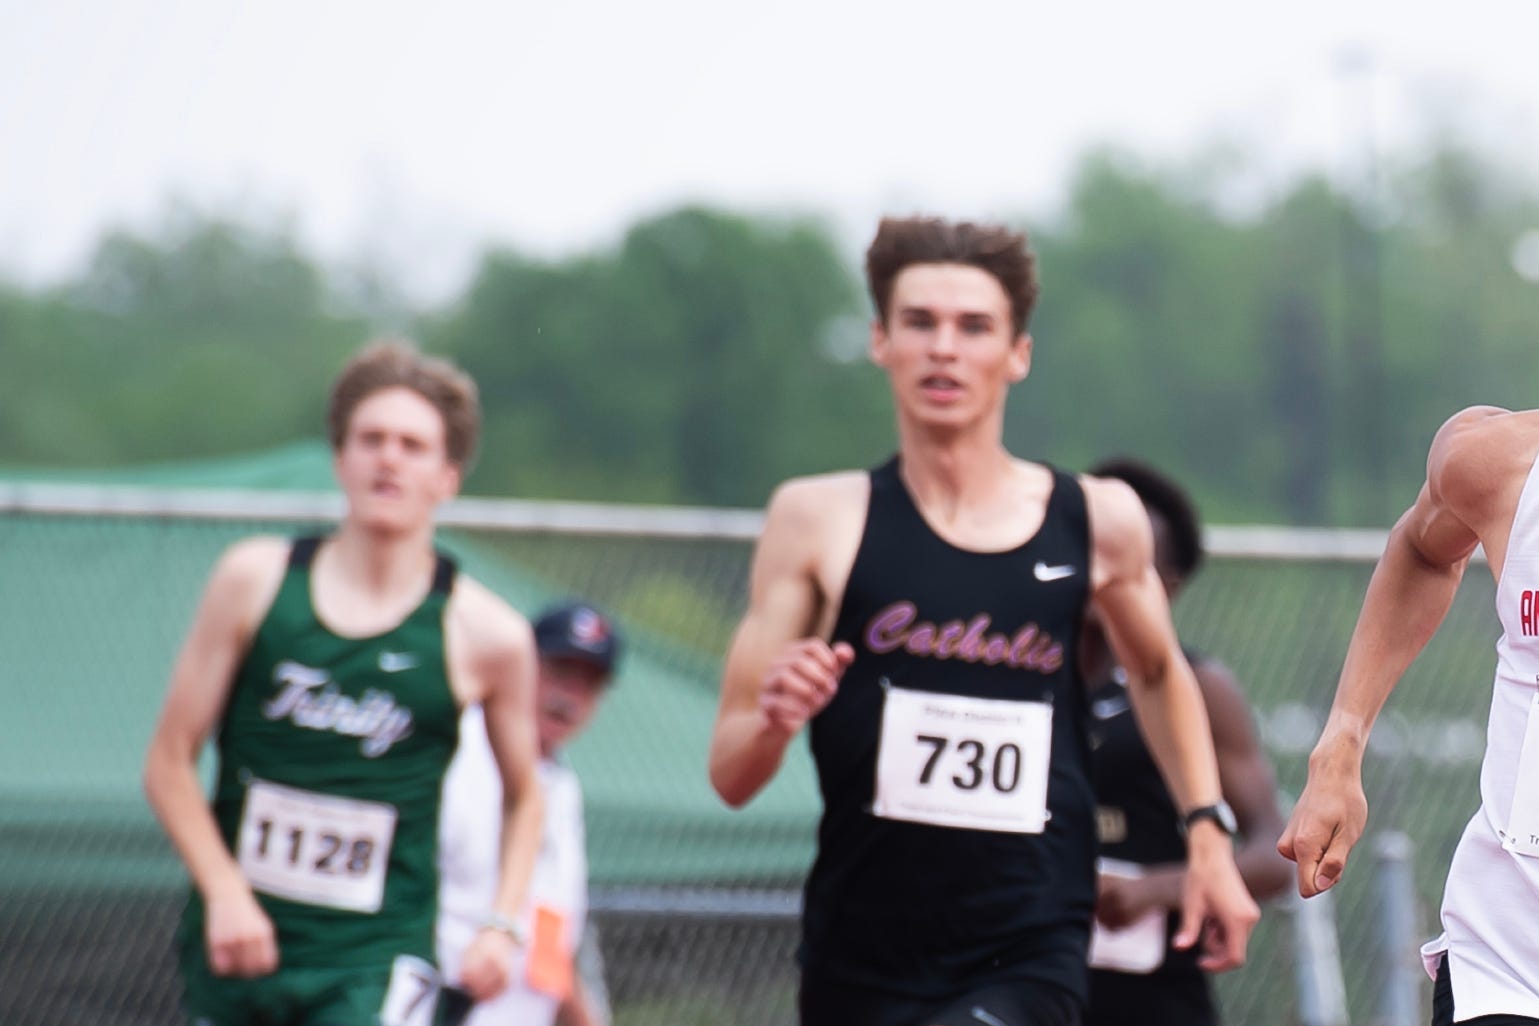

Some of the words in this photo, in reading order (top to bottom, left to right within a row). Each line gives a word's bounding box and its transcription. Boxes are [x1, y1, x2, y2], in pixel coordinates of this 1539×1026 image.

[866, 600, 1063, 674] Catholic
[263, 660, 413, 758] Trinity
[916, 734, 1021, 793] 730
[257, 819, 374, 877] 1128
[402, 970, 432, 1022] 7
